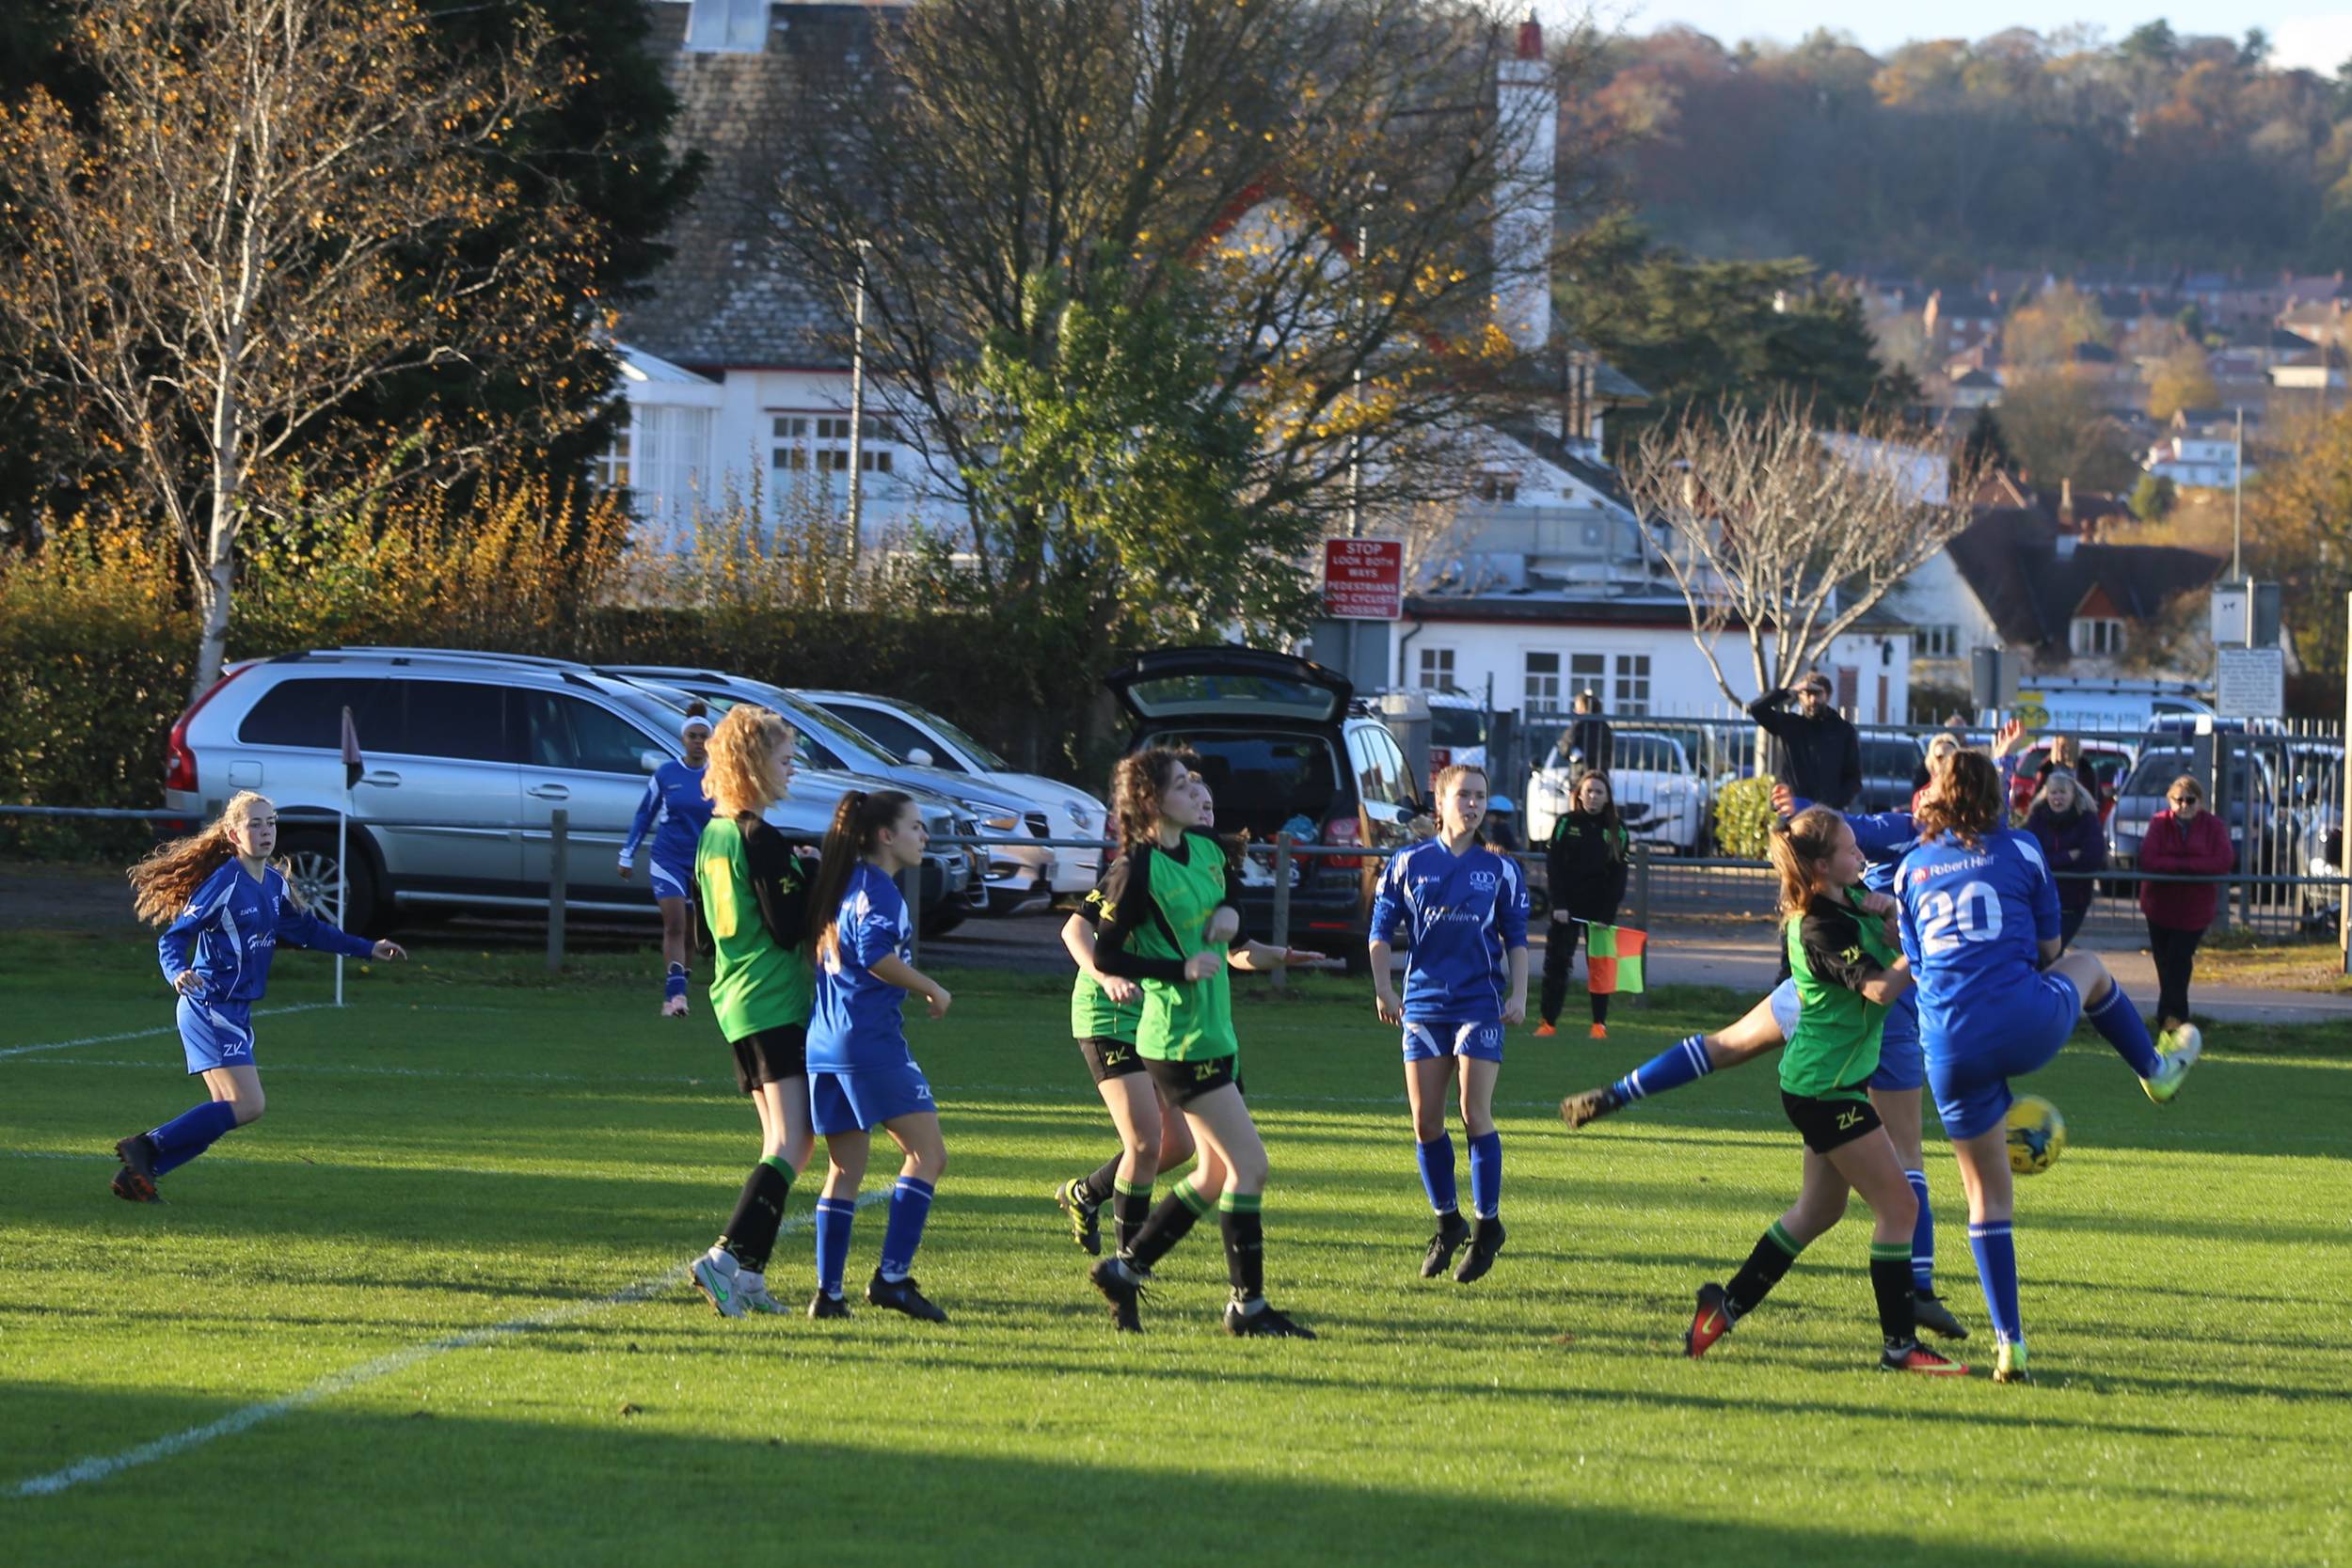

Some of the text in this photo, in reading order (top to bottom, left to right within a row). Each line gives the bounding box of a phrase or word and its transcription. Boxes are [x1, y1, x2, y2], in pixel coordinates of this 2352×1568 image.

[1346, 543, 1383, 555] STOP
[1332, 556, 1395, 567] LOOK BOTH
[1348, 568, 1379, 578] WAYS
[1327, 581, 1397, 593] PEDESTRIANS
[1350, 594, 1399, 605] CYCLISTS
[1335, 604, 1389, 616] CROSSING
[1930, 858, 1968, 878] Robert
[1971, 854, 1995, 868] Half
[1917, 880, 2003, 956] 20
[223, 1040, 246, 1057] ZK
[1105, 1046, 1130, 1066] ZK
[1194, 1059, 1220, 1082] ZK
[1836, 1105, 1865, 1131] ZK
